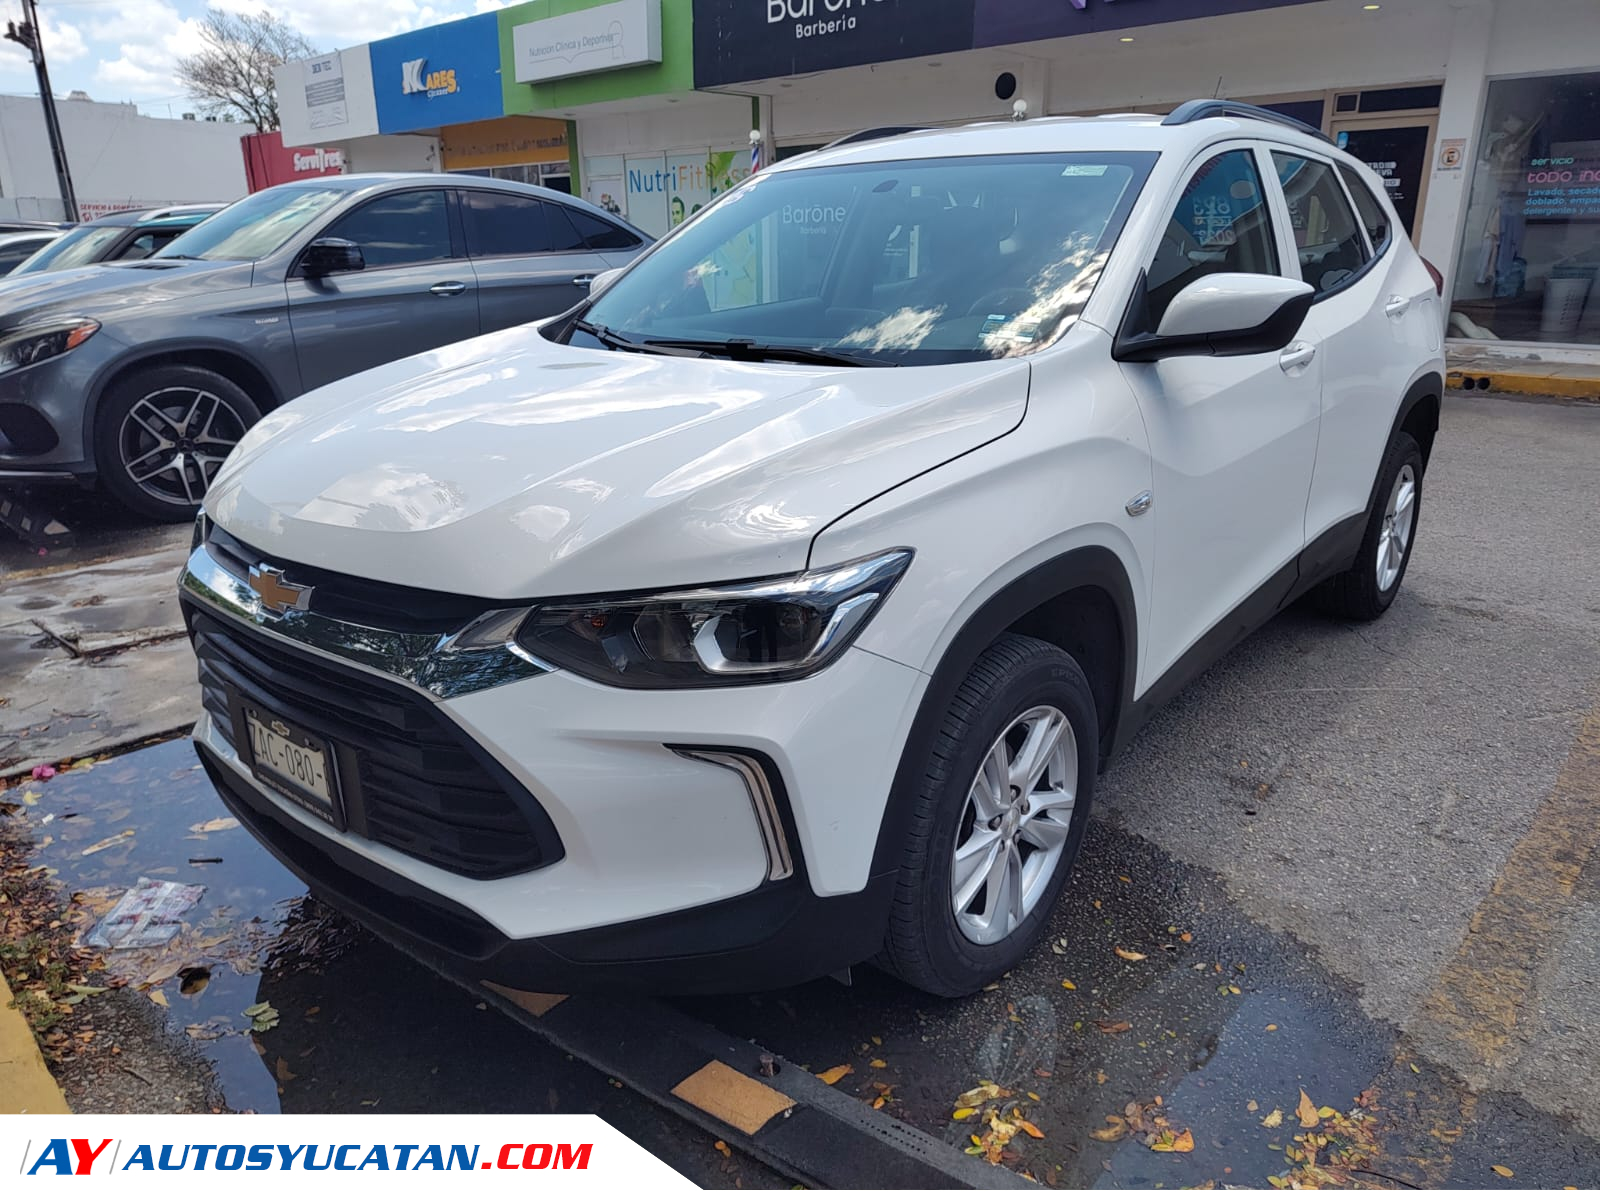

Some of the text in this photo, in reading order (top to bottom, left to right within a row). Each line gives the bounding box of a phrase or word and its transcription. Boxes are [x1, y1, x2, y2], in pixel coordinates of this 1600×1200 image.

[795, 14, 856, 38] Barbería
[1531, 157, 1574, 166] servicio
[247, 722, 329, 787] ZAC-080-
